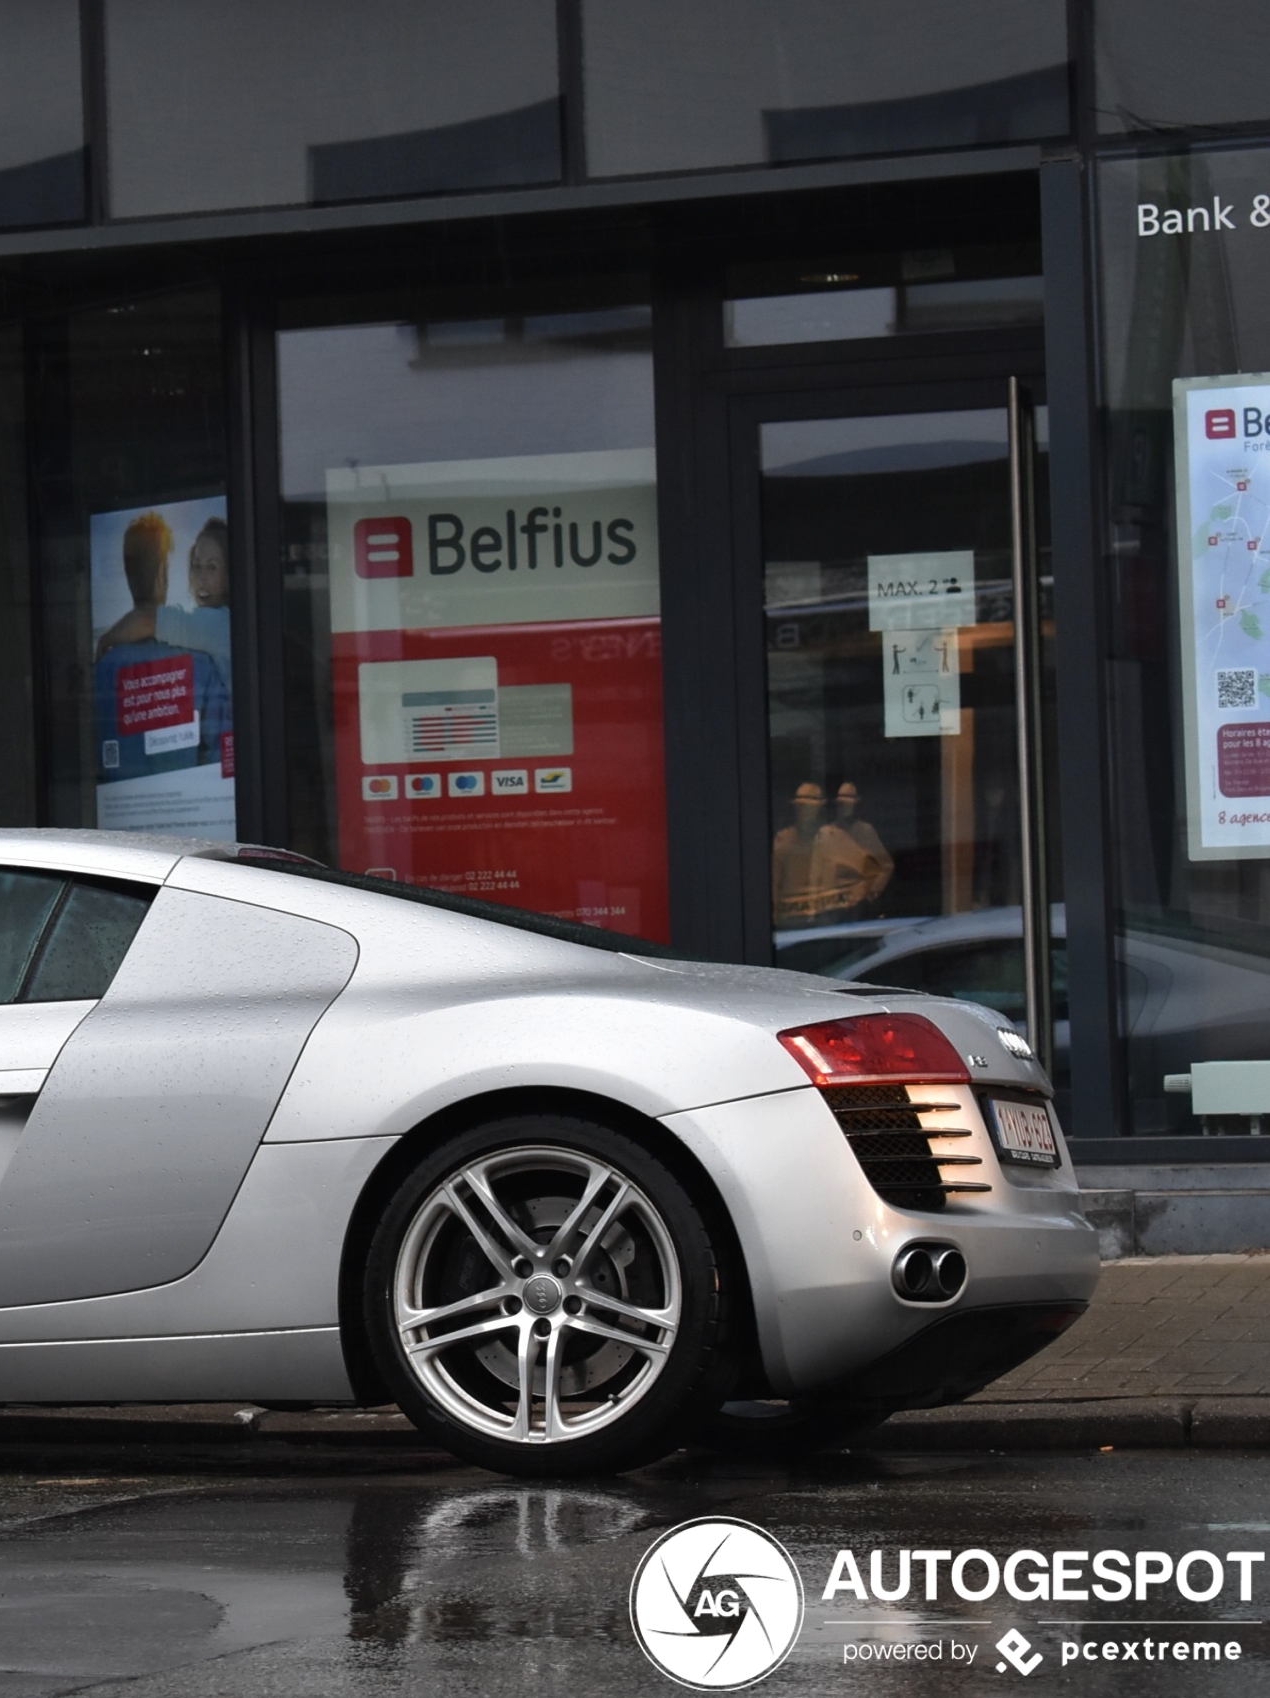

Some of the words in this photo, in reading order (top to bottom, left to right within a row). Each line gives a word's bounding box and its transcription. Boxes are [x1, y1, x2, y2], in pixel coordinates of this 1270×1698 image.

[1137, 196, 1236, 236] Bank
[1250, 194, 1270, 227] &
[427, 506, 637, 576] Belfius
[877, 580, 923, 598] MAX.
[928, 579, 939, 595] 2
[122, 679, 140, 690] Vous
[140, 668, 187, 688] accompagner
[123, 695, 135, 708] est
[136, 692, 153, 706] pour
[153, 688, 171, 701] nous
[171, 685, 187, 701] plus
[1222, 728, 1256, 738] Horaires
[1223, 740, 1241, 750] pour
[1242, 738, 1254, 748] les
[1255, 737, 1262, 747] 8
[496, 775, 524, 788] VISA
[1218, 810, 1226, 825] 8
[465, 871, 476, 880] 02
[477, 870, 493, 880] 222
[494, 869, 505, 878] 44
[506, 869, 517, 878] 44
[468, 882, 478, 891] 02
[480, 881, 496, 890] 222
[496, 880, 508, 889] 44
[508, 880, 520, 889] 44
[575, 907, 591, 917] 070
[593, 906, 608, 916] 344
[610, 906, 625, 916] 344
